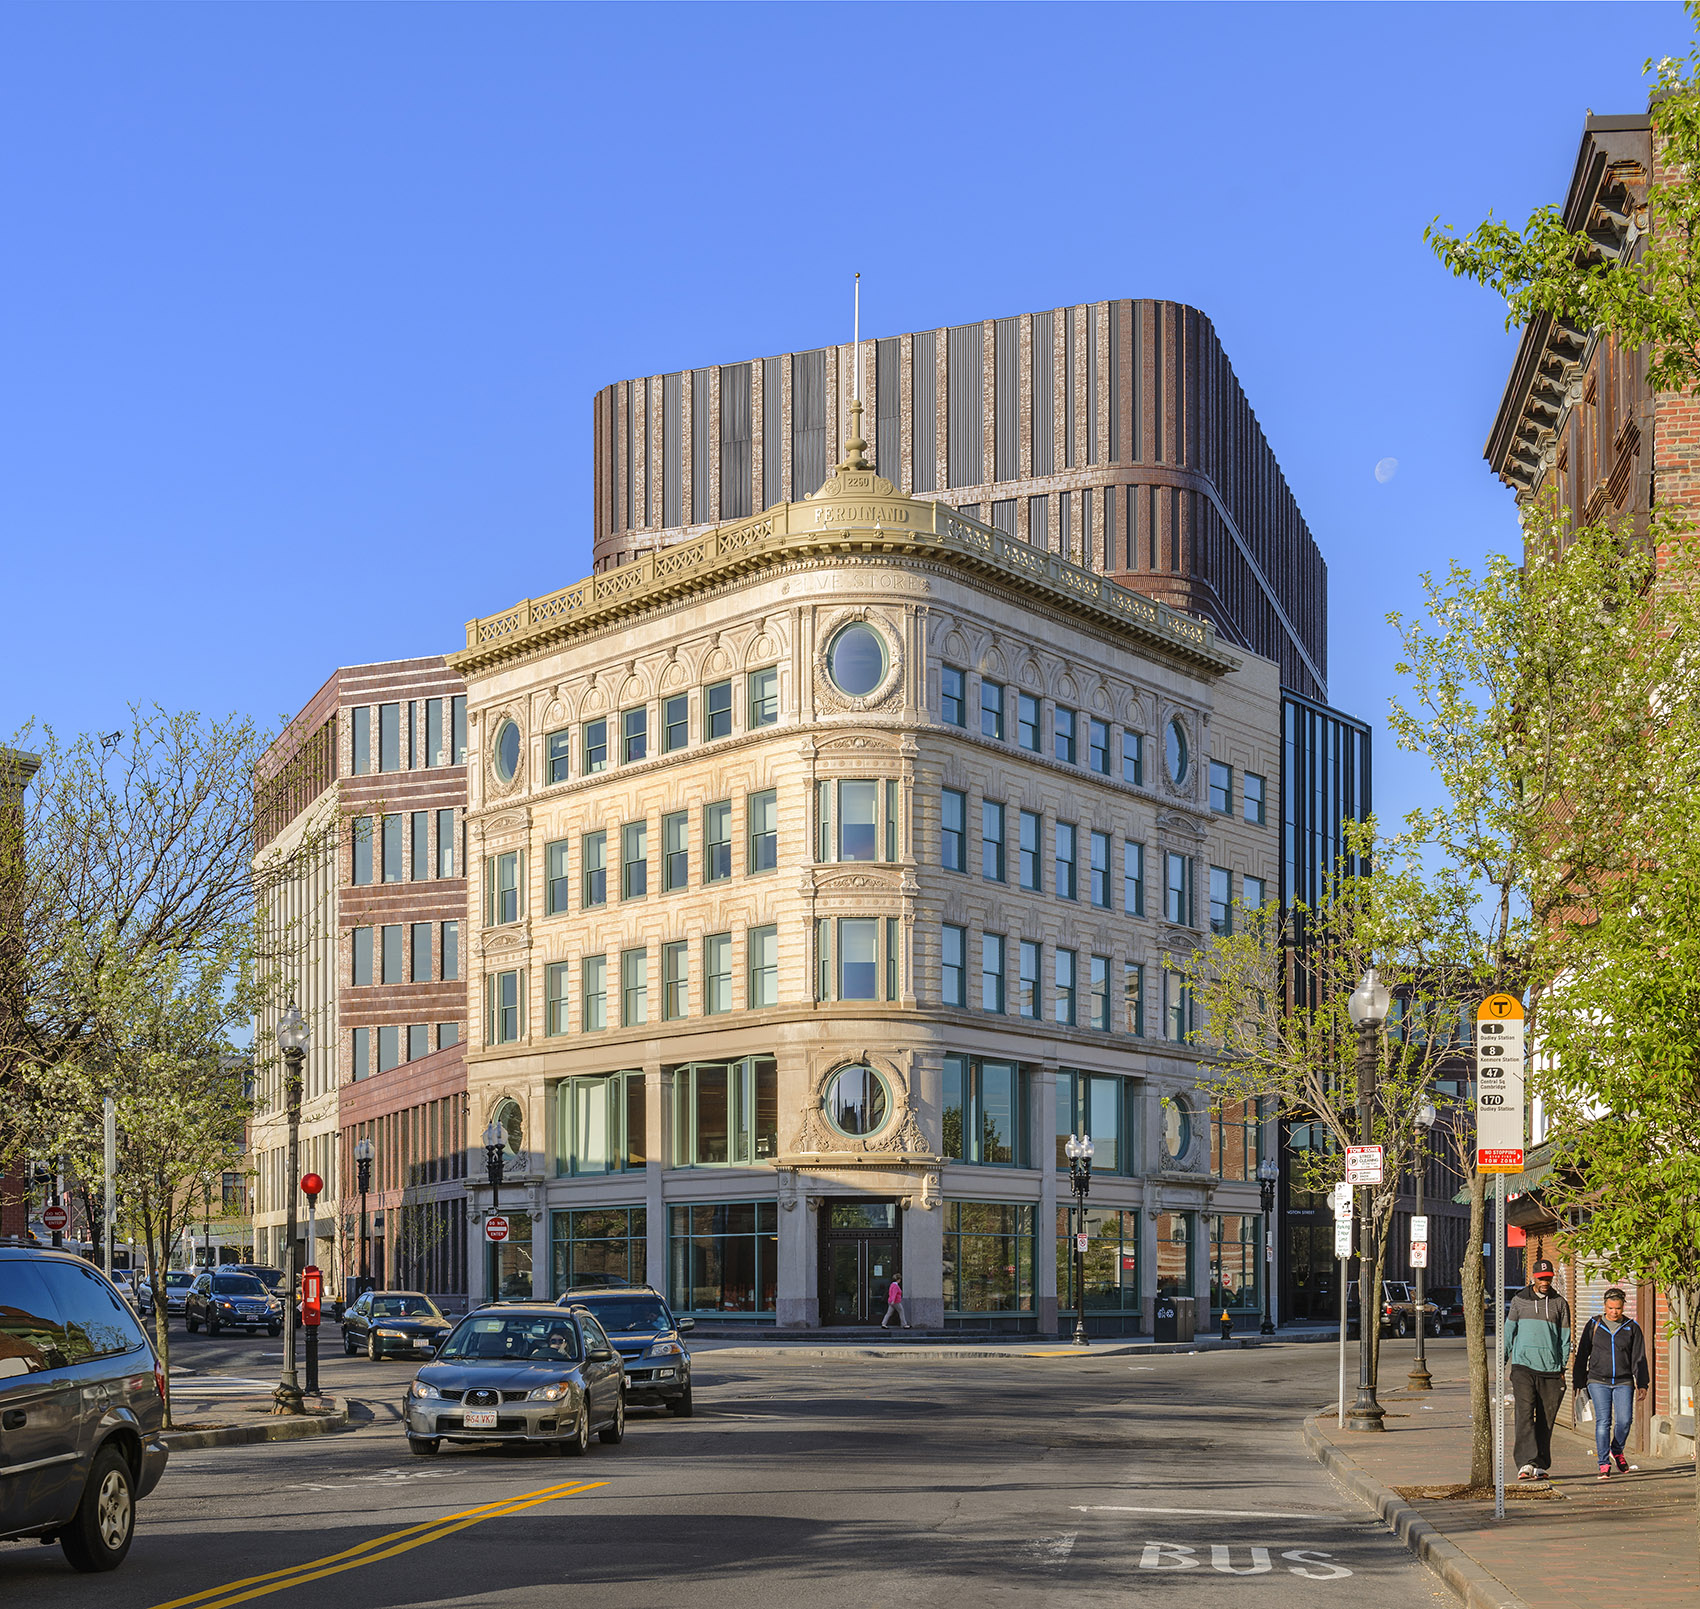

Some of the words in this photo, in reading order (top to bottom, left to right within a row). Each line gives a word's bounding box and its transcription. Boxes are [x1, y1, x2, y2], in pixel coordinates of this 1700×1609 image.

[814, 506, 910, 523] FERDINAND
[853, 573, 921, 590] STORE
[1493, 1002, 1508, 1014] T
[1490, 1024, 1495, 1034] 1
[1489, 1046, 1496, 1055] 8
[1486, 1068, 1499, 1077] 47
[1483, 1095, 1501, 1105] 170
[1541, 1262, 1547, 1271] B
[481, 1414, 495, 1424] VK7
[1138, 1540, 1354, 1580] BUS
